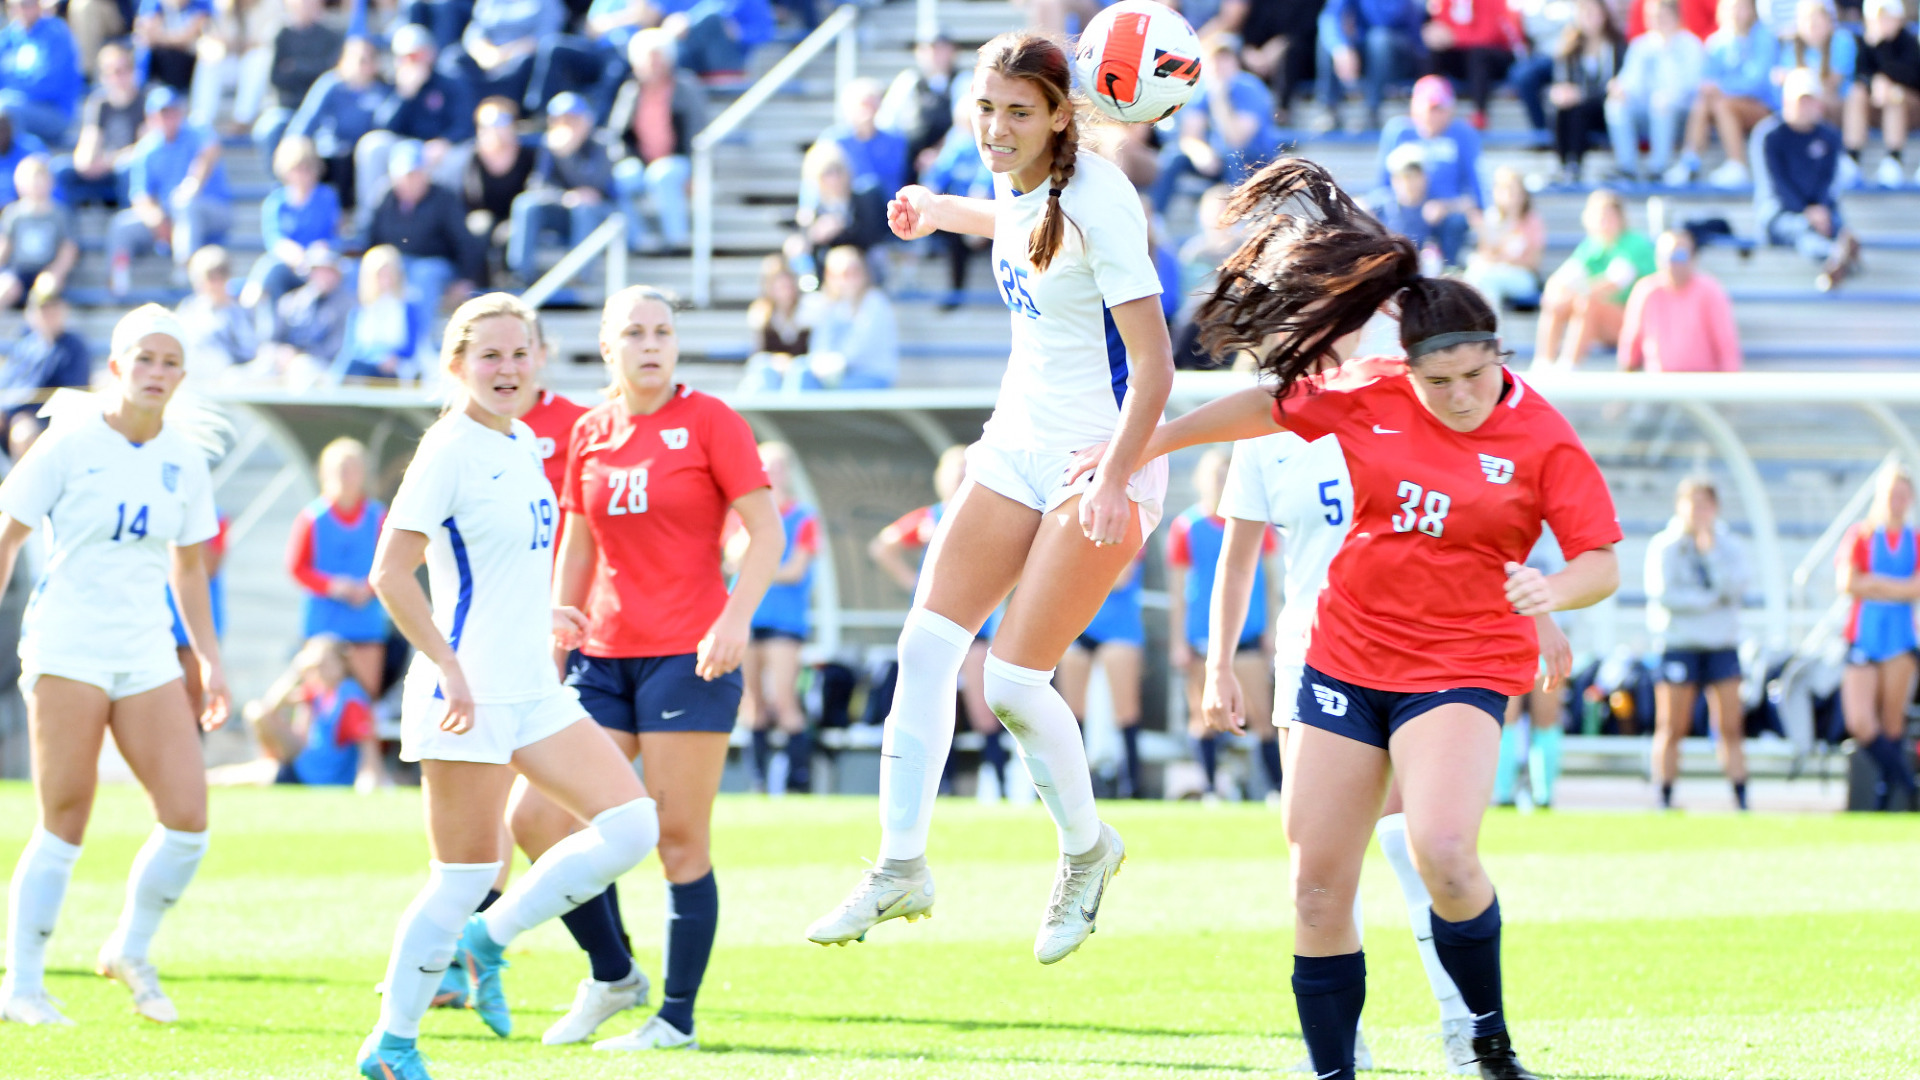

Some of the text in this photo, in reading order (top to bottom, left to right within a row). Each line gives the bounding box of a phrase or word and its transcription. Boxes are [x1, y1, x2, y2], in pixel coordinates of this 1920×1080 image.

[1000, 258, 1041, 320] 25
[608, 468, 648, 516] 28
[1319, 479, 1343, 526] 5
[1391, 479, 1451, 538] 38
[110, 502, 148, 541] 14
[529, 498, 551, 550] 19
